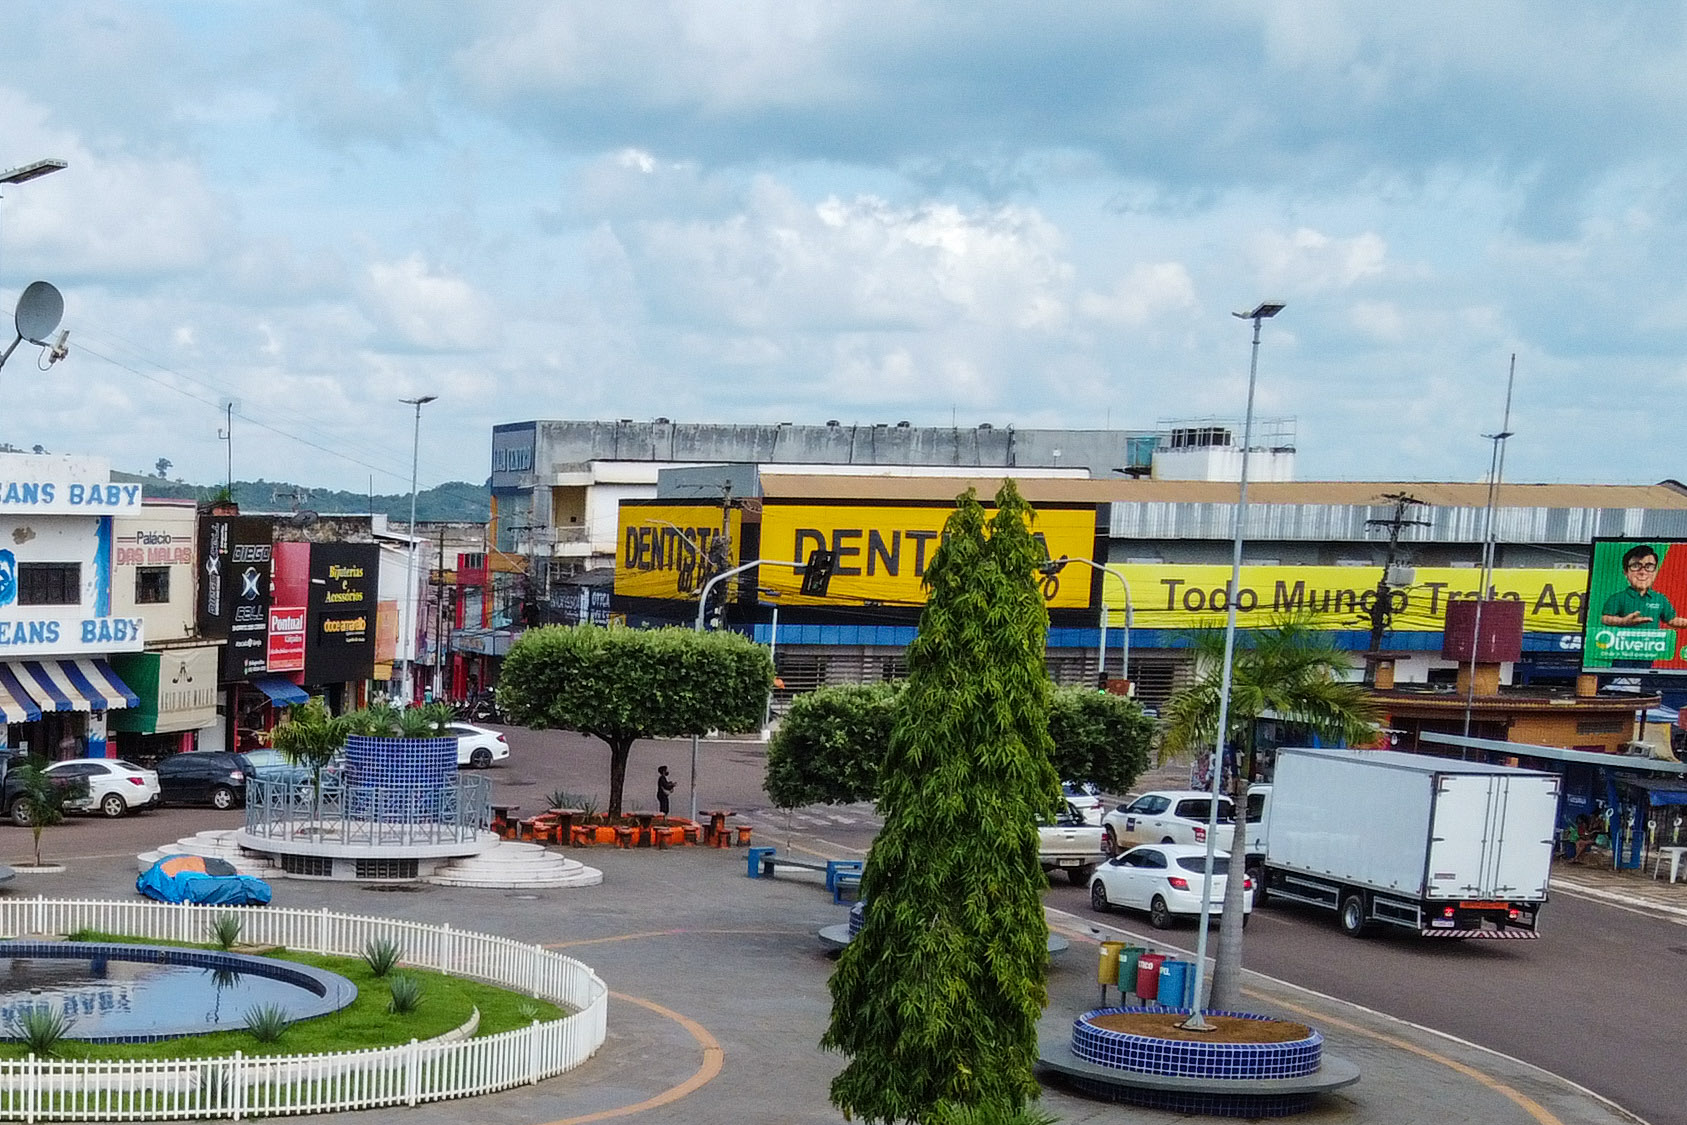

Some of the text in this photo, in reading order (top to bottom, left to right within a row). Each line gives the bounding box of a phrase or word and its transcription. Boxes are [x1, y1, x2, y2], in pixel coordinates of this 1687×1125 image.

[69, 483, 140, 506] BABY
[136, 530, 172, 545] Palácio
[116, 547, 192, 566] DAS MALAS
[625, 526, 723, 572] DENTIST
[342, 580, 348, 589] e
[325, 589, 364, 603] Acessórios
[1160, 579, 1258, 613] Todo
[81, 618, 143, 643] BABY
[1595, 630, 1666, 651] Oliveira
